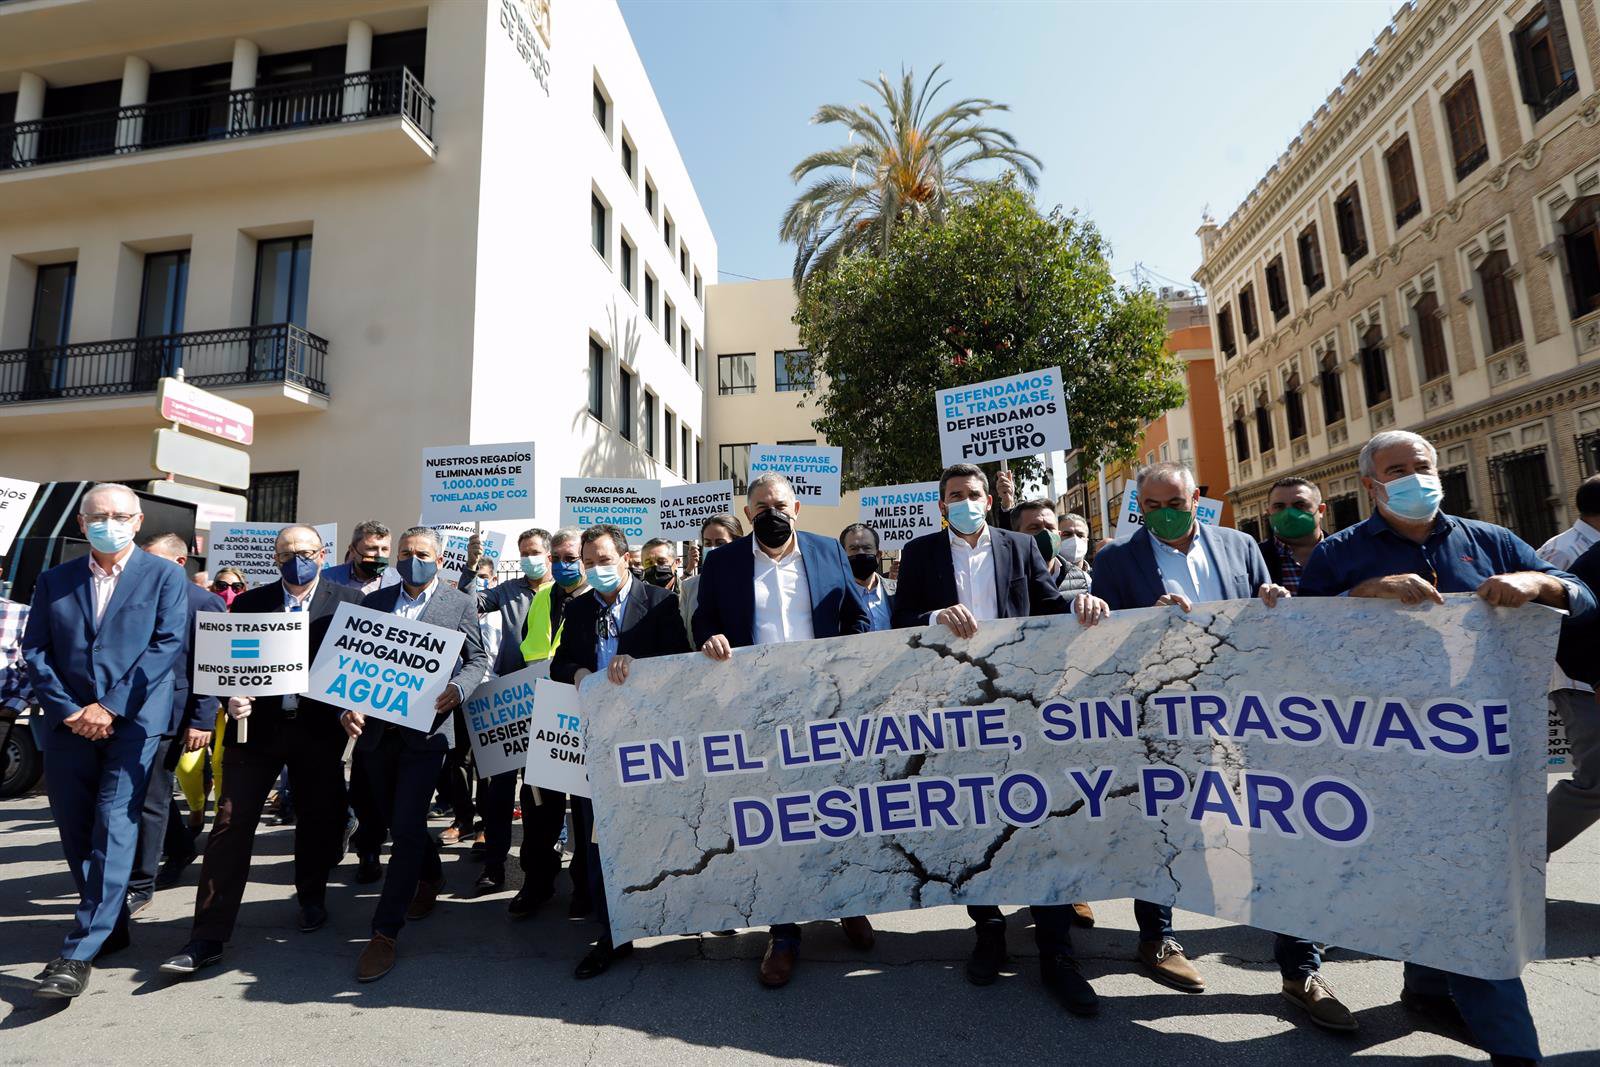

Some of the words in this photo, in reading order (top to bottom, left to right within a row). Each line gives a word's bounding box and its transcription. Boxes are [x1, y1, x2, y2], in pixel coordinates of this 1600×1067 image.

[500, 8, 514, 41] DE
[944, 375, 1053, 406] DEFENDAMOS
[945, 407, 963, 418] EL
[967, 389, 1055, 415] TRASVASE,
[947, 403, 1056, 432] DEFENDAMOS
[971, 423, 1034, 442] NUESTRO
[962, 432, 1045, 459] FUTURO
[426, 457, 478, 467] NUESTROS
[481, 452, 531, 464] REGADÍOS
[760, 454, 777, 462] SIN
[780, 455, 830, 464] TRASVASE
[435, 468, 482, 478] ELIMINAN
[485, 465, 506, 475] MÁS
[509, 466, 522, 474] DE
[752, 463, 770, 471] NO
[770, 464, 791, 472] HAY
[794, 465, 838, 473] FUTURO
[442, 478, 499, 489] 1.000.000
[501, 478, 515, 486] DE
[795, 476, 807, 484] EL
[430, 492, 489, 502] TONELADAS
[491, 491, 504, 499] DE
[507, 490, 527, 498] CO2
[565, 496, 611, 504] TRASVASE
[672, 498, 684, 507] AL
[686, 492, 731, 505] RECORTE
[861, 496, 878, 507] SIN
[881, 492, 939, 505] TRASVASE
[475, 501, 497, 512] AÑO
[660, 510, 677, 519] DEL
[679, 504, 729, 517] TRASVASE
[875, 506, 907, 518] MILES
[909, 505, 924, 515] DE
[578, 516, 592, 524] EL
[595, 516, 642, 525] CAMBIO
[866, 518, 915, 529] FAMILIAS
[918, 517, 933, 527] AL
[884, 530, 913, 540] PARO
[443, 550, 455, 559] EN
[199, 622, 232, 632] MENOS
[235, 622, 302, 632] TRASVASE
[345, 616, 384, 637] NOS
[385, 626, 446, 654] ESTÁN
[334, 635, 440, 674] AHOGANDO
[198, 664, 230, 673] MENOS
[232, 663, 303, 674] SUMIDEROS
[338, 655, 351, 669] Y
[351, 660, 379, 678] NO
[381, 668, 425, 692] CON
[218, 676, 236, 686] DE
[239, 675, 273, 686] CO2
[325, 673, 409, 717] AGUA
[467, 696, 491, 716] SIN
[494, 682, 534, 708] AGUA
[472, 716, 489, 732] EL
[536, 729, 580, 748] ADIÓS
[619, 740, 686, 783] EN
[703, 733, 764, 773] EL
[780, 707, 1023, 767] LEVANTE,
[1042, 702, 1133, 742] SIN
[1154, 694, 1510, 757] TRASVASE
[503, 737, 529, 757] PAR
[733, 773, 1048, 847] DESIERTO
[1070, 769, 1113, 818] Y
[1142, 768, 1369, 843] PARO
